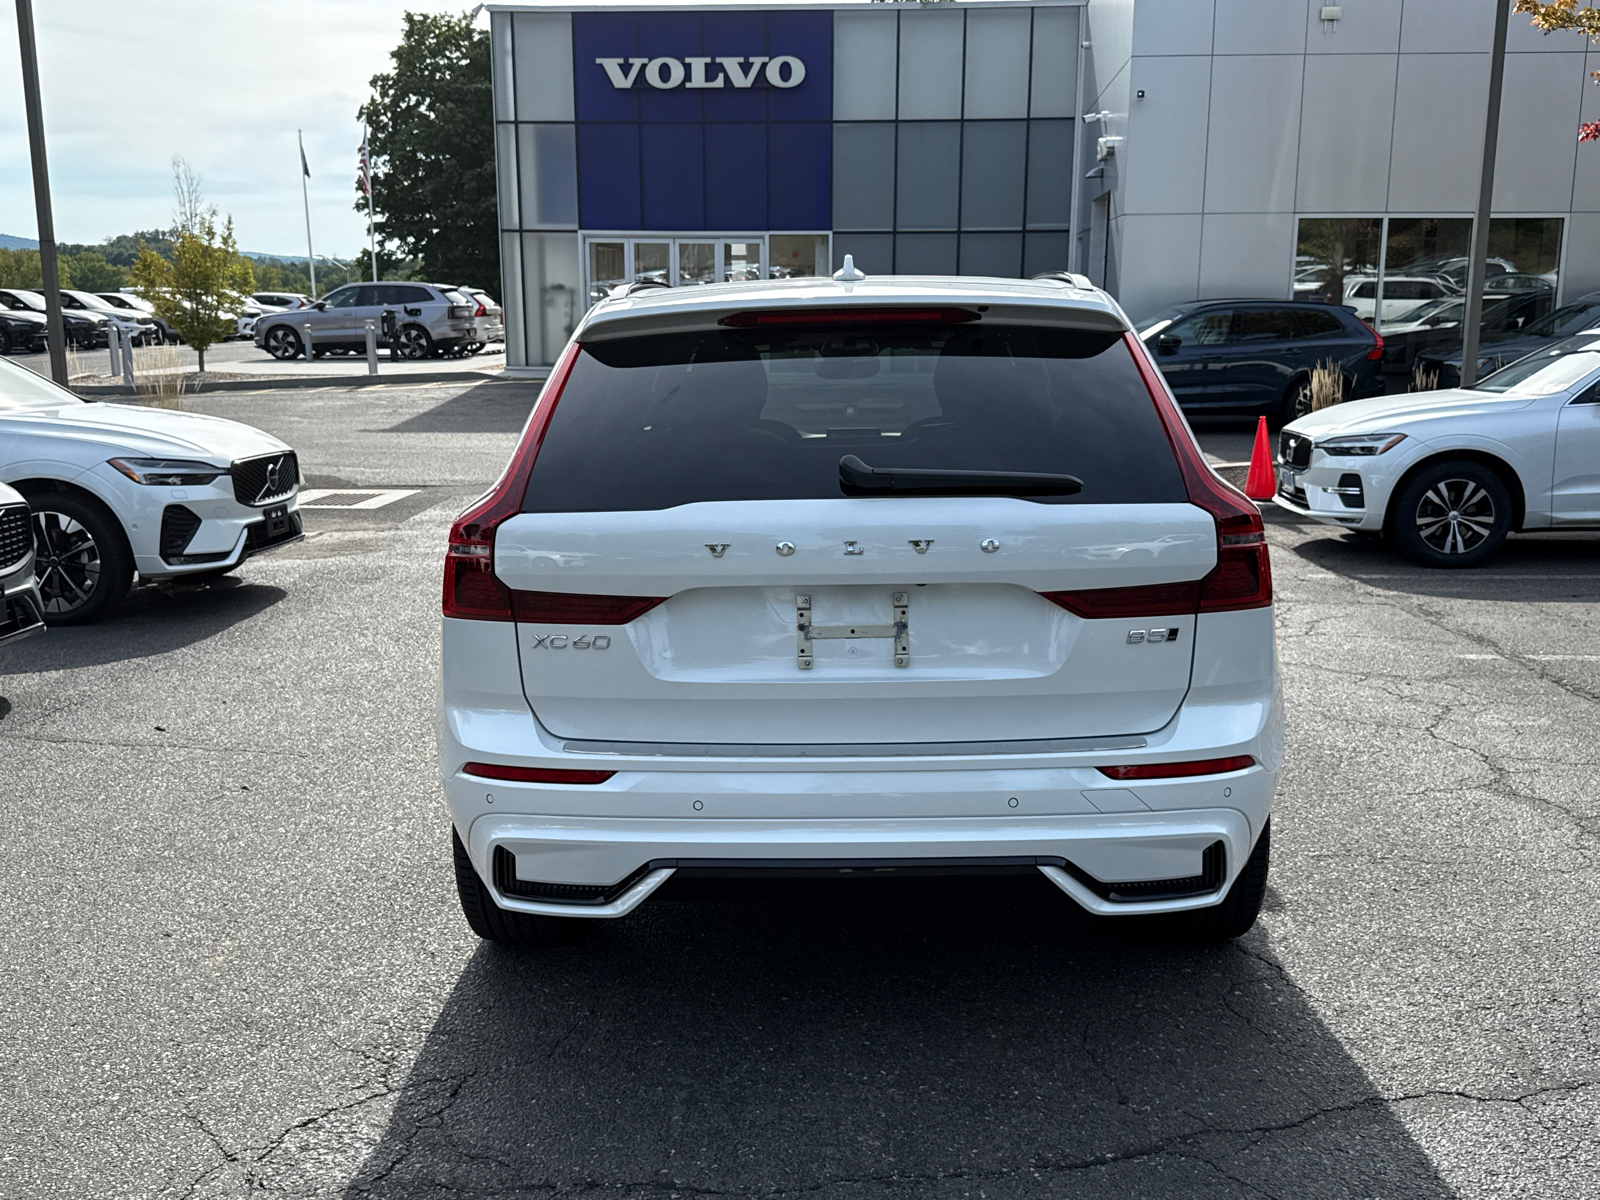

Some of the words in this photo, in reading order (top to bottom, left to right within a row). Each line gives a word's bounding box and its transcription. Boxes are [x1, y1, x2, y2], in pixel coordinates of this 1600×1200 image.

[595, 55, 806, 89] VOLVO
[704, 538, 1001, 558] VOLVO
[532, 634, 611, 650] XC60
[1126, 628, 1167, 644] B5
